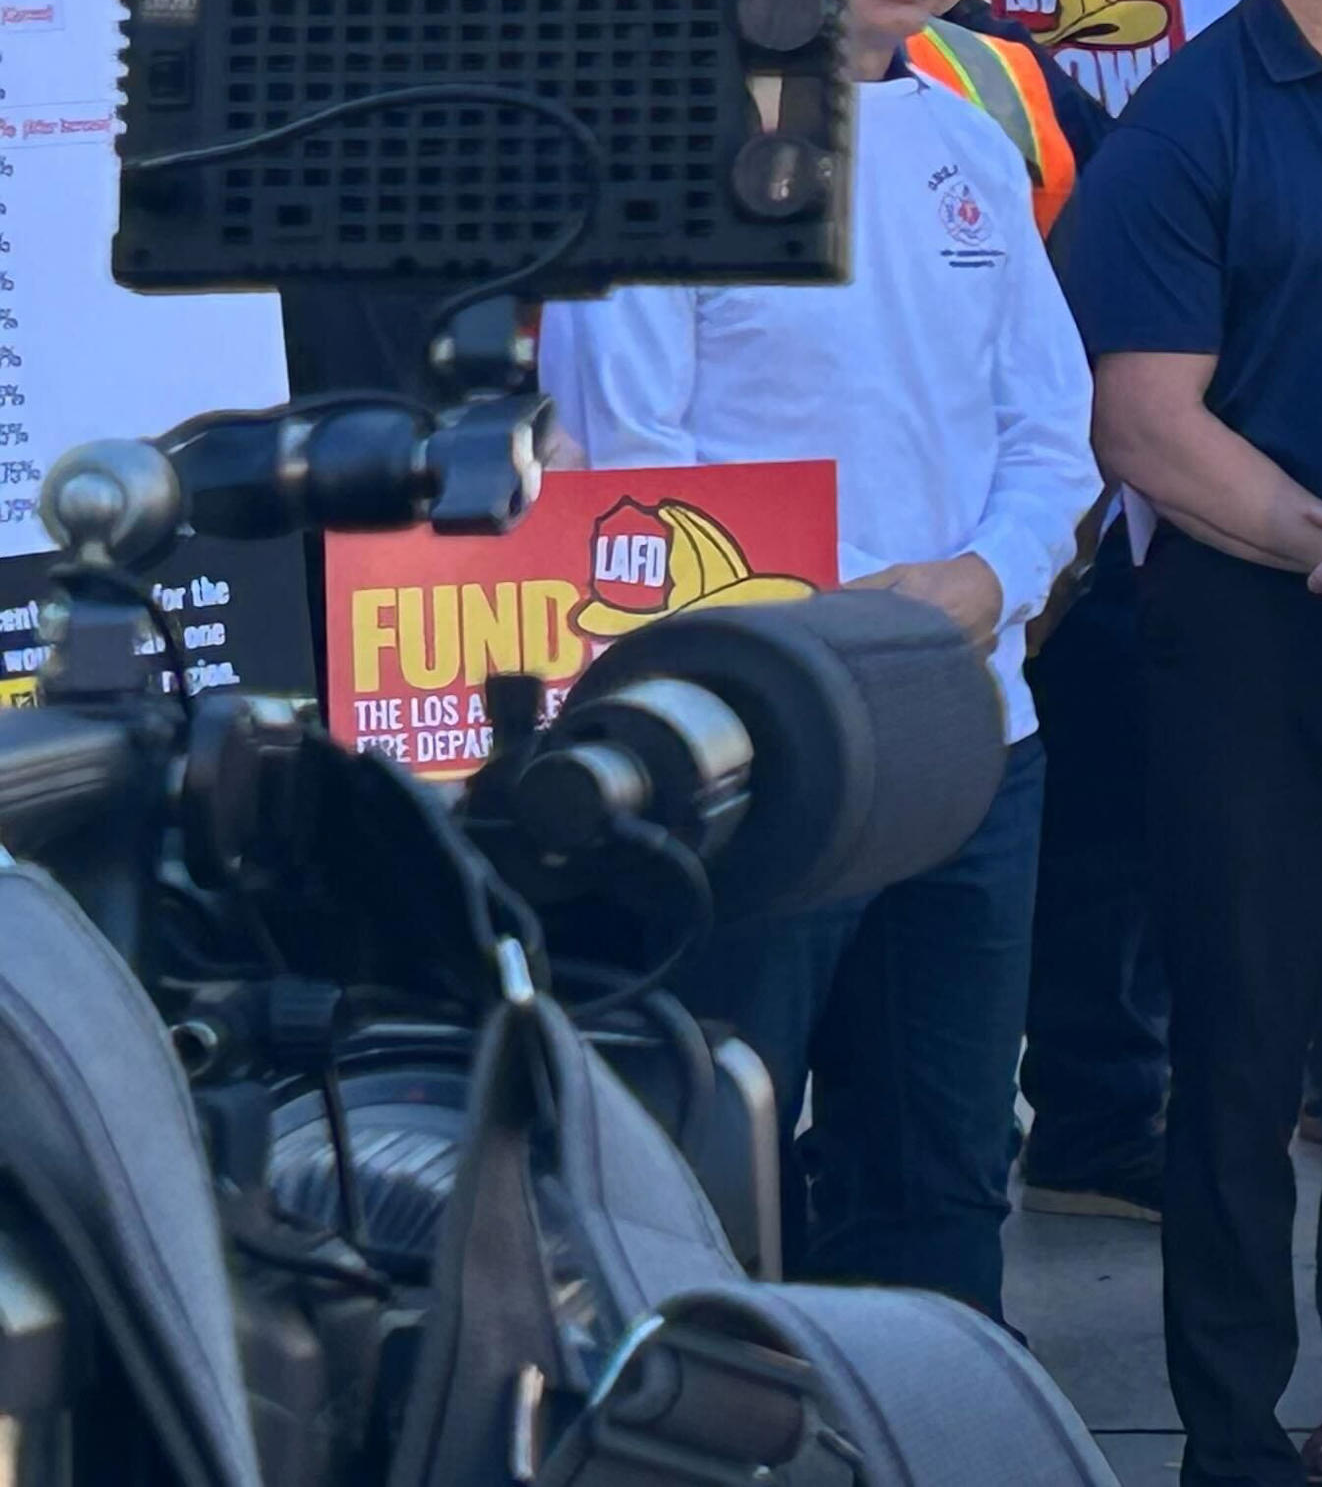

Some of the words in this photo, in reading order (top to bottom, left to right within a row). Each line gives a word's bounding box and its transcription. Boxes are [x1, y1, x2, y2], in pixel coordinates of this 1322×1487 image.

[596, 534, 668, 589] LAFD
[191, 576, 230, 607] the
[184, 622, 226, 649] one
[352, 579, 587, 694] FUND
[354, 698, 404, 732] THE
[410, 694, 461, 728] LOS
